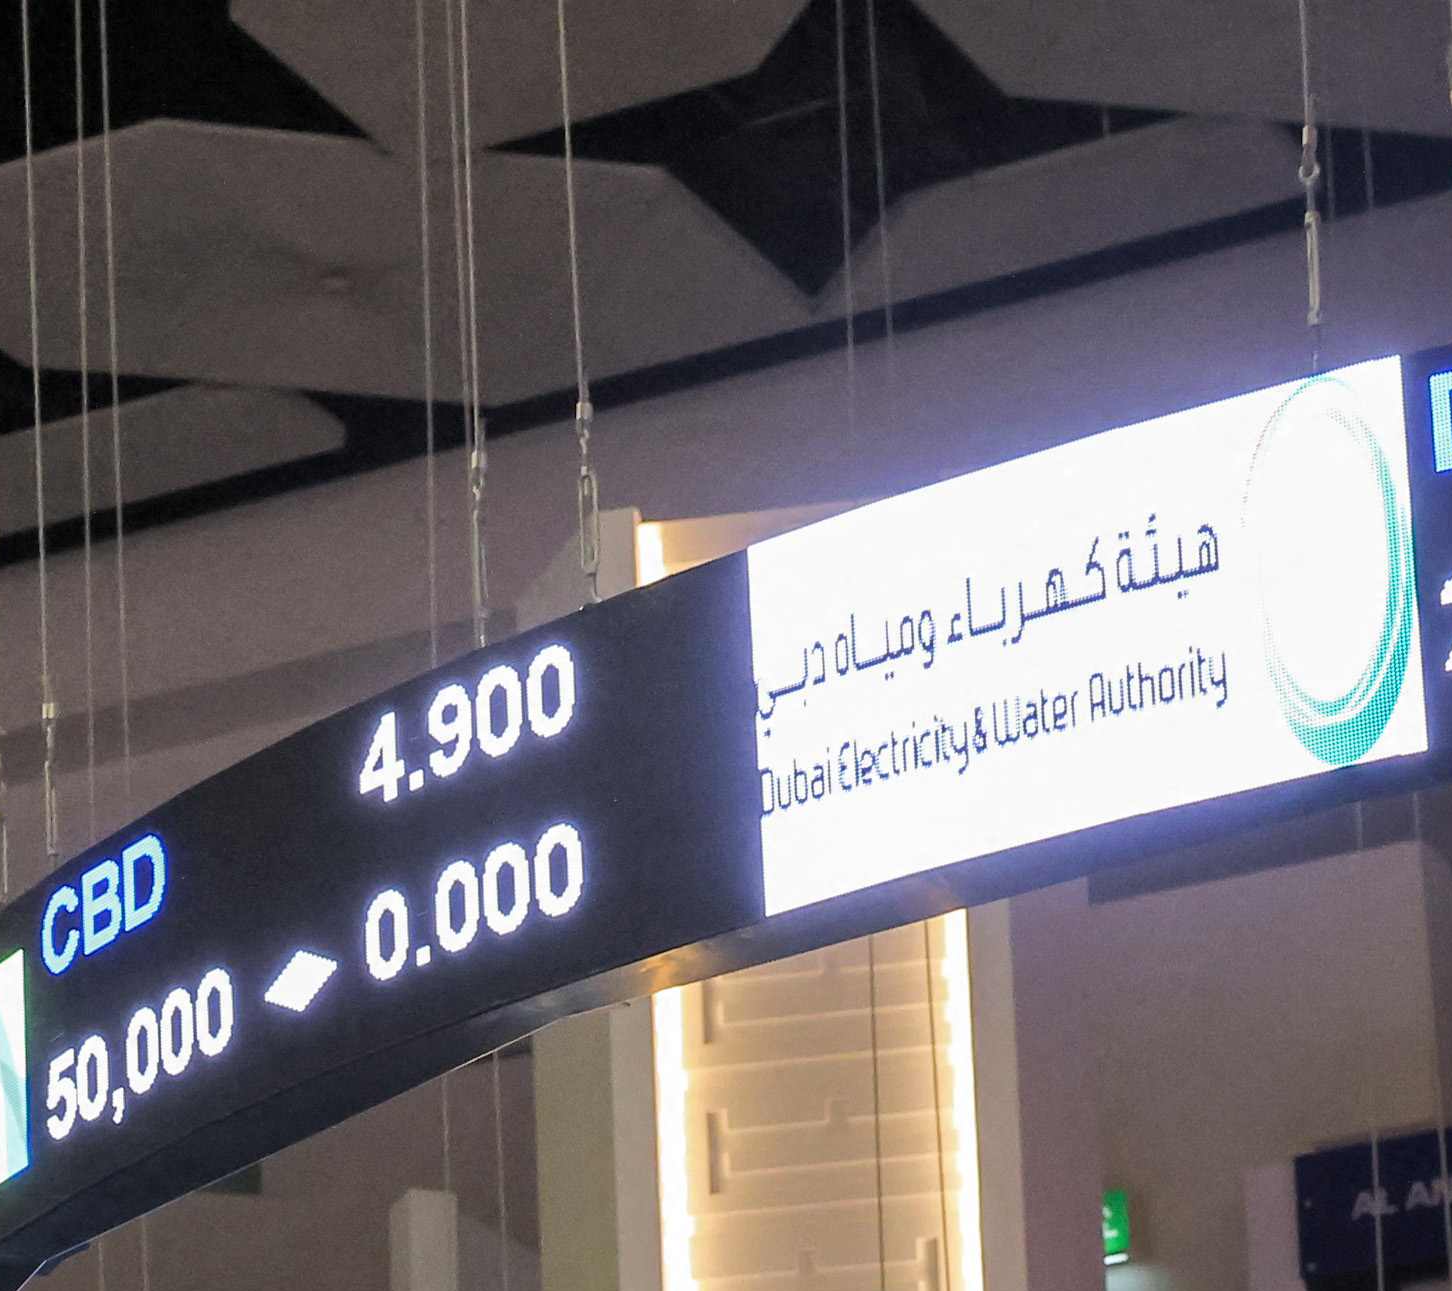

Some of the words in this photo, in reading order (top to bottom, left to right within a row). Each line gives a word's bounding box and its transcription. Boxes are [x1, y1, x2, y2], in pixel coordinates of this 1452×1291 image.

[945, 537, 1107, 648] كهرباء
[1117, 514, 1220, 602] هيئة
[753, 640, 826, 740] دبي
[835, 609, 936, 683] ومياه
[358, 643, 577, 804] 4.900
[759, 746, 832, 818] Dubai
[992, 688, 1079, 747] Water
[1088, 645, 1229, 724] Authority
[41, 833, 168, 977] CBD
[363, 822, 585, 983] 0.000
[46, 966, 235, 1142] 50,000
